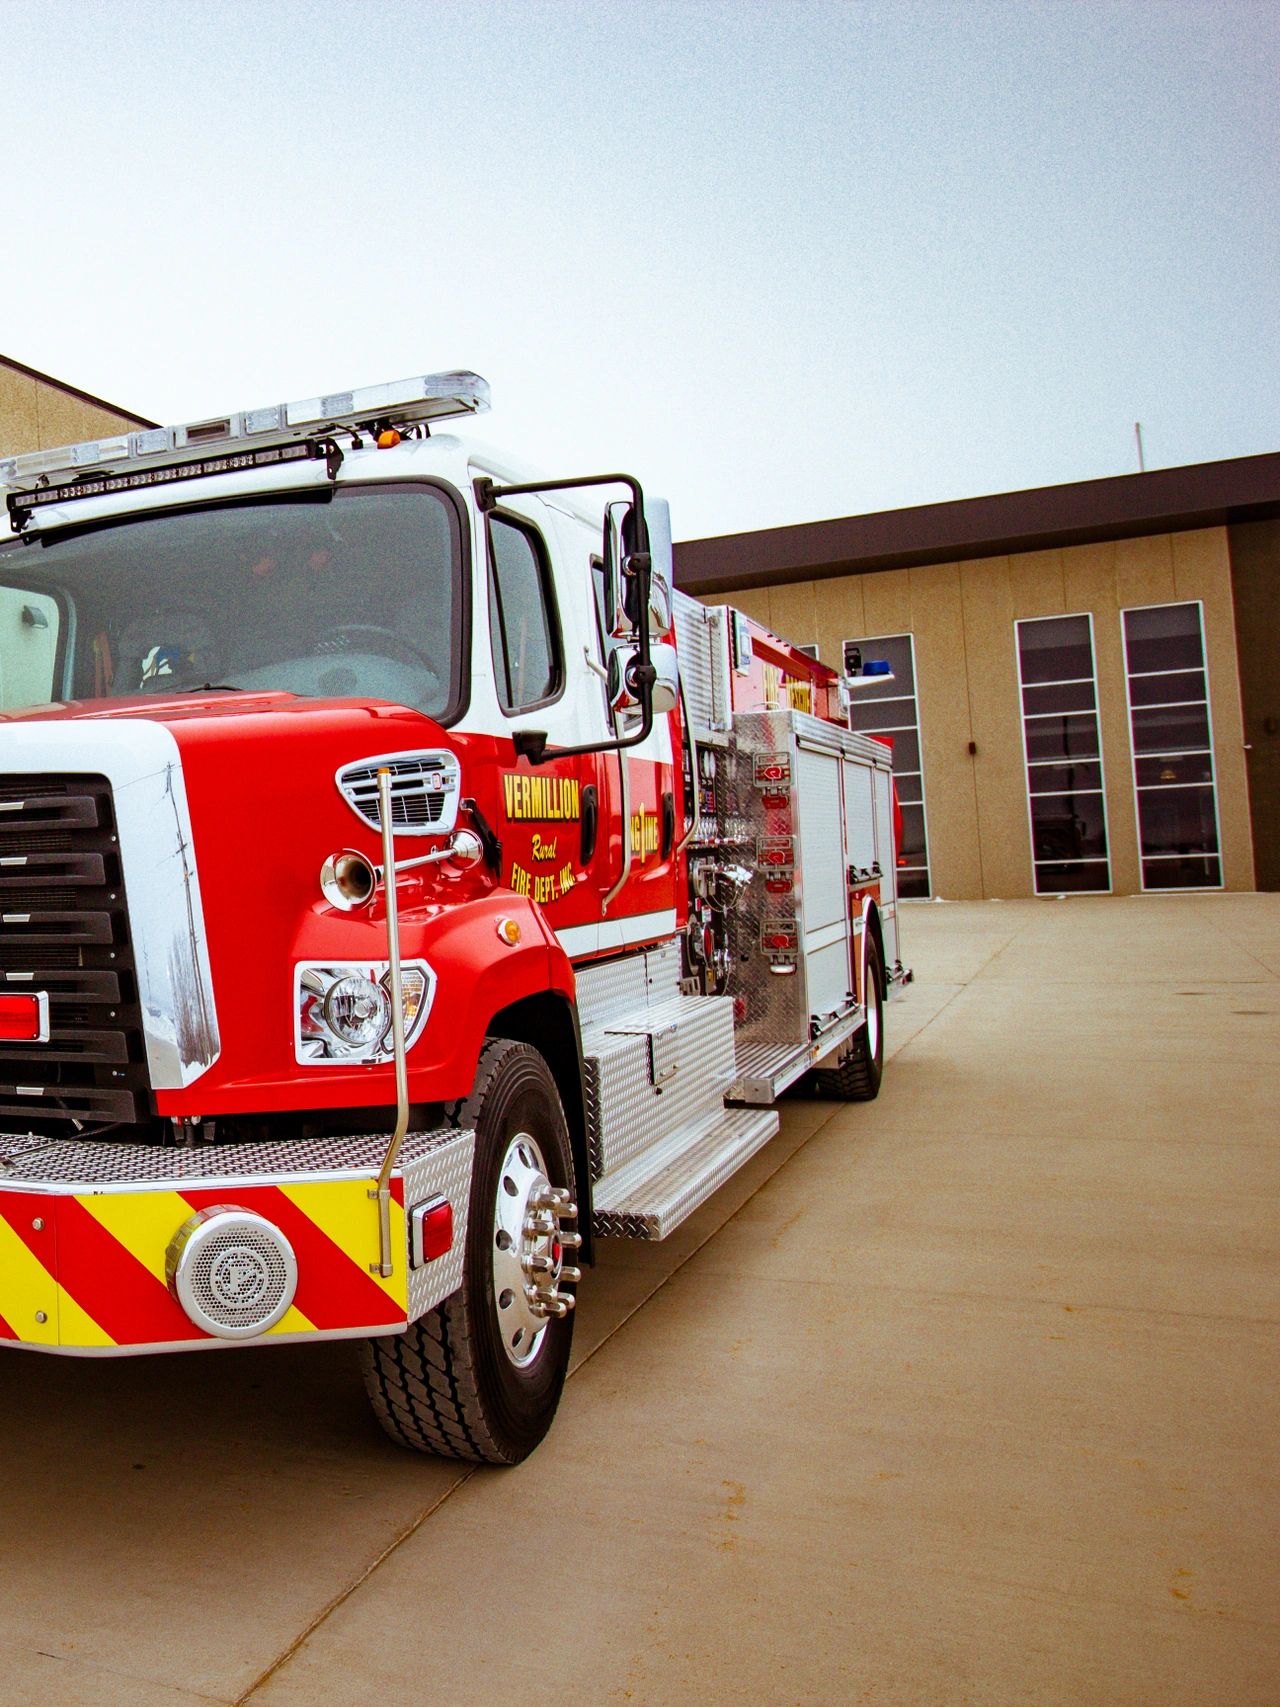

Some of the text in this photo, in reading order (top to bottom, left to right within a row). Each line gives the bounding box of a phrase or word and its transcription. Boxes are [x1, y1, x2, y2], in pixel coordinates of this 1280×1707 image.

[503, 774, 580, 821] VERMILLION
[532, 833, 557, 861] Rural
[631, 801, 658, 864] NG1INE
[511, 862, 532, 897] FIRE
[534, 874, 559, 903] DEPT.
